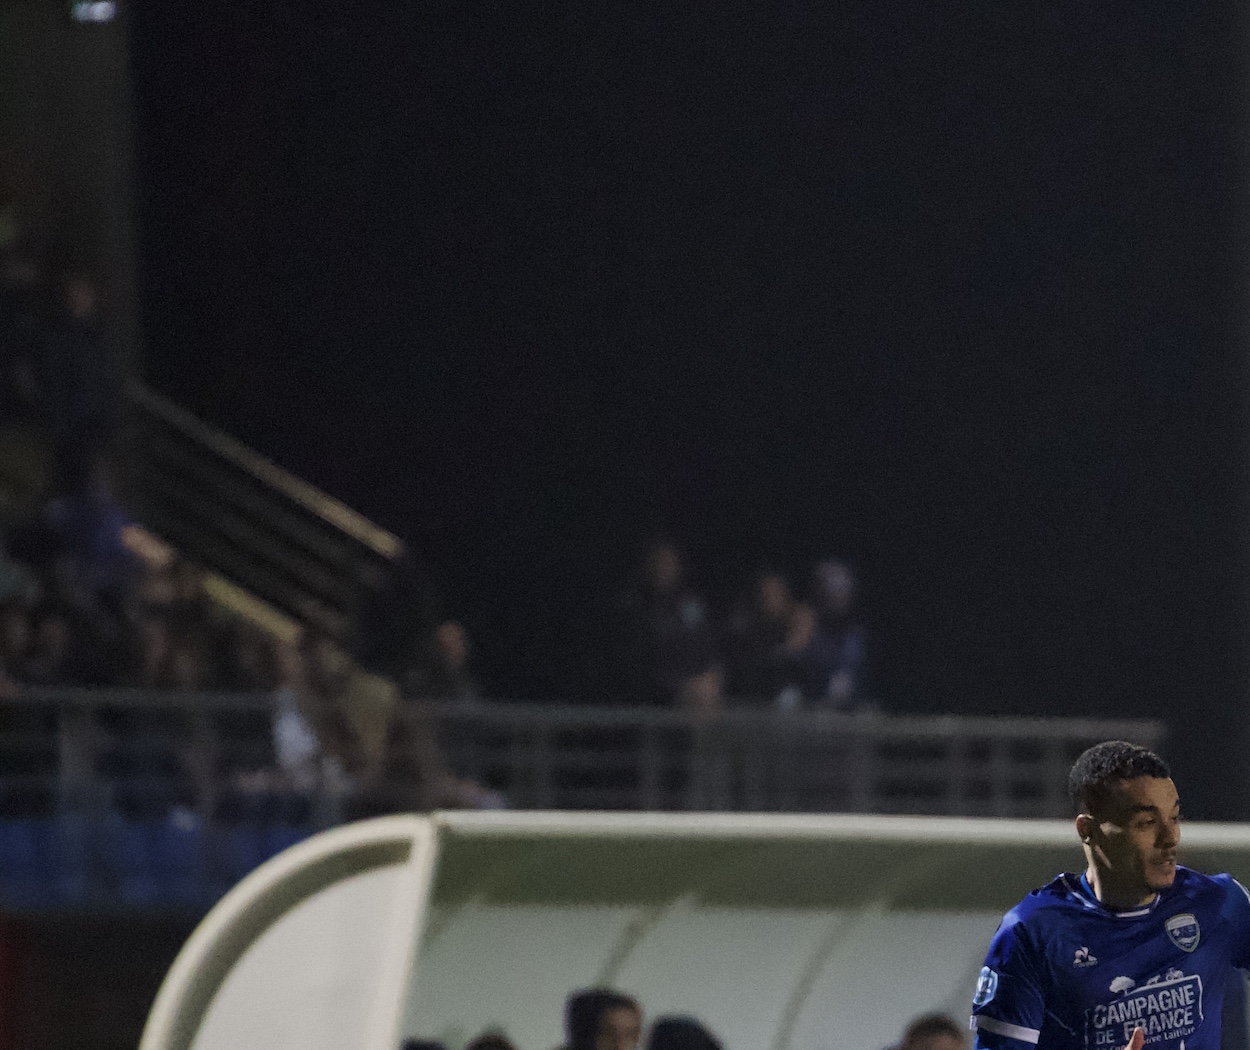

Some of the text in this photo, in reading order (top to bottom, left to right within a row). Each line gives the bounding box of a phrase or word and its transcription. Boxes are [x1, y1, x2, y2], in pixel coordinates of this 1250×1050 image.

[1093, 984, 1196, 1029] CAMPAGNE
[1095, 1005, 1194, 1045] DE FRANCE
